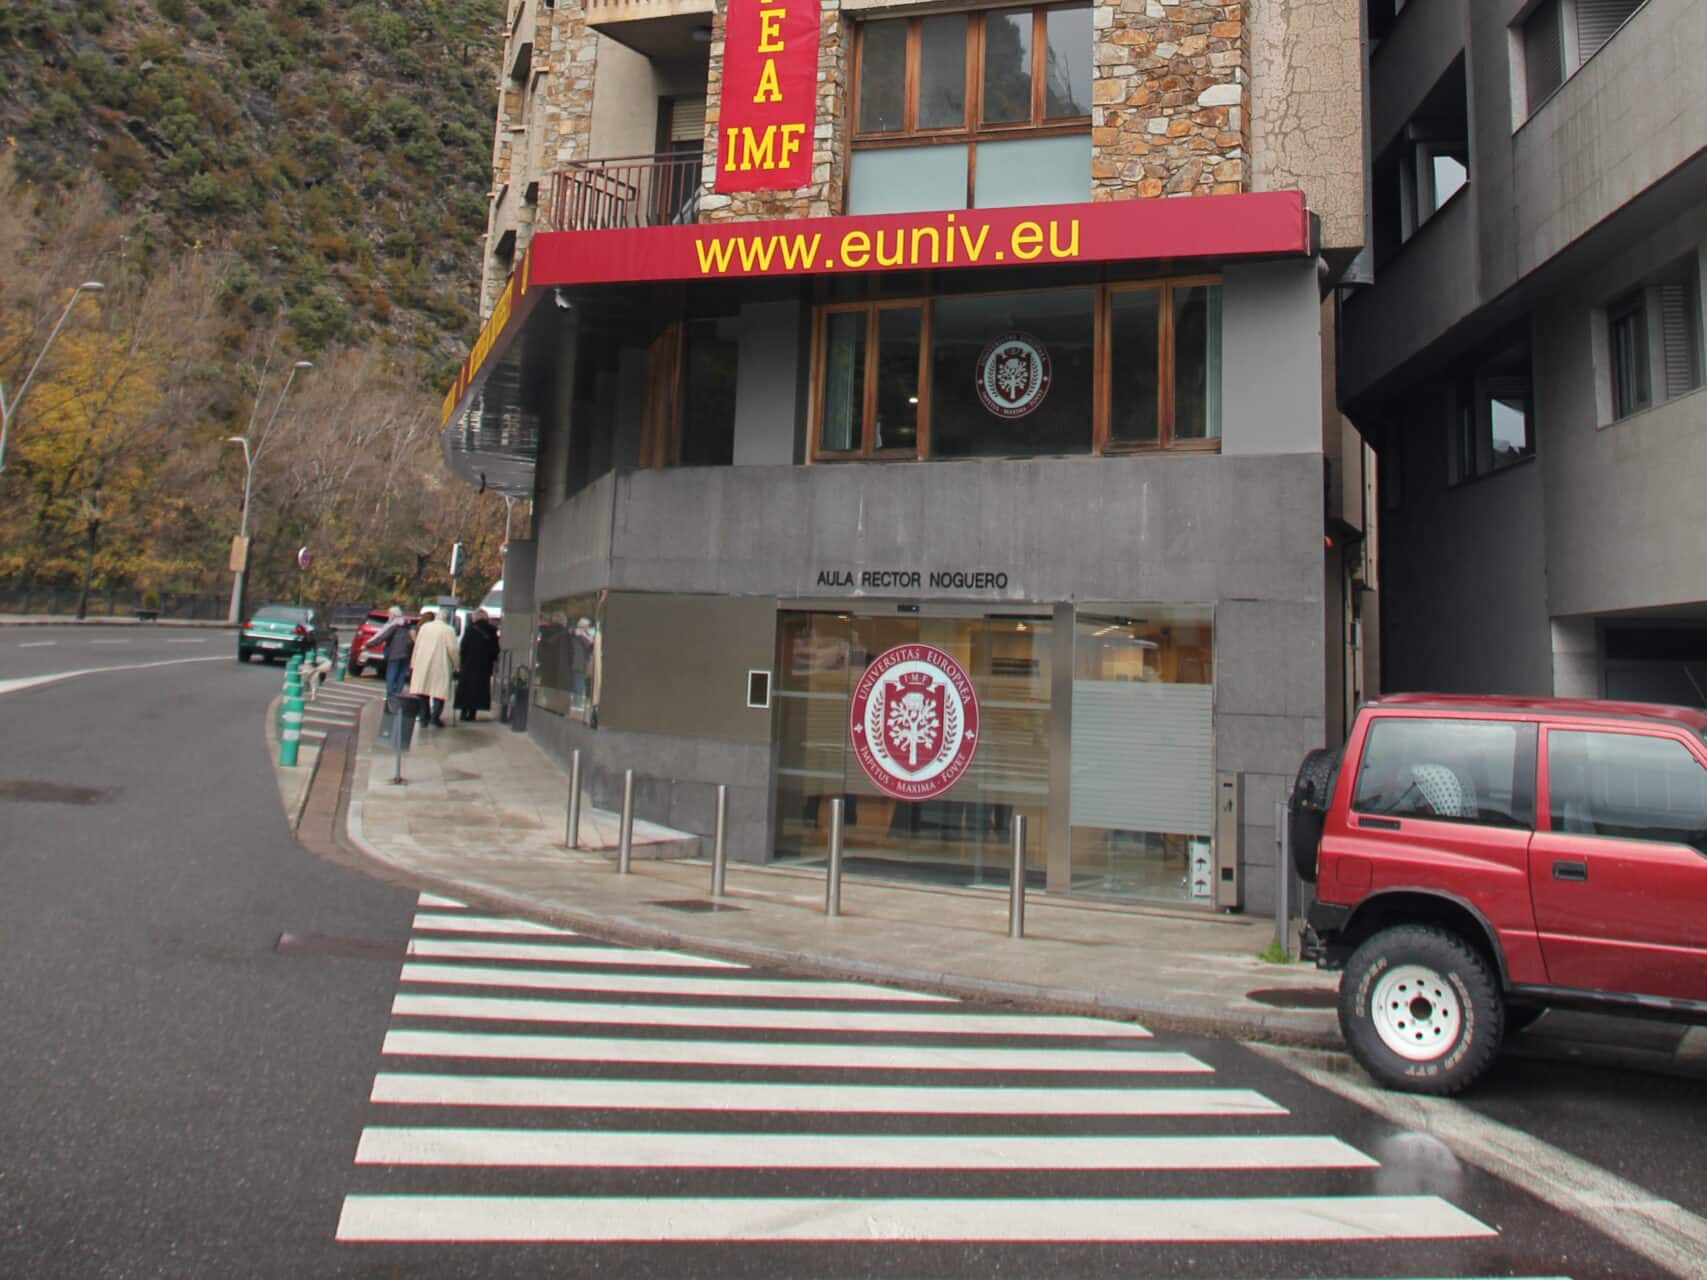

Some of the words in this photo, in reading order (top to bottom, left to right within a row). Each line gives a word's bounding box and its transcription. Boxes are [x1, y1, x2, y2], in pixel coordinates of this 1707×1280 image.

[725, 123, 806, 171] IMF
[696, 215, 1080, 273] www.euniv.eu
[817, 571, 854, 586] AULA
[861, 572, 921, 588] RECTOR
[929, 572, 1008, 589] NOGUERO
[858, 648, 920, 701] UNIVERSITAS
[927, 651, 971, 705] EUROPAEA
[860, 745, 890, 784] IMPETUS
[896, 782, 936, 793] MAXIMA
[942, 753, 965, 782] FOVET
